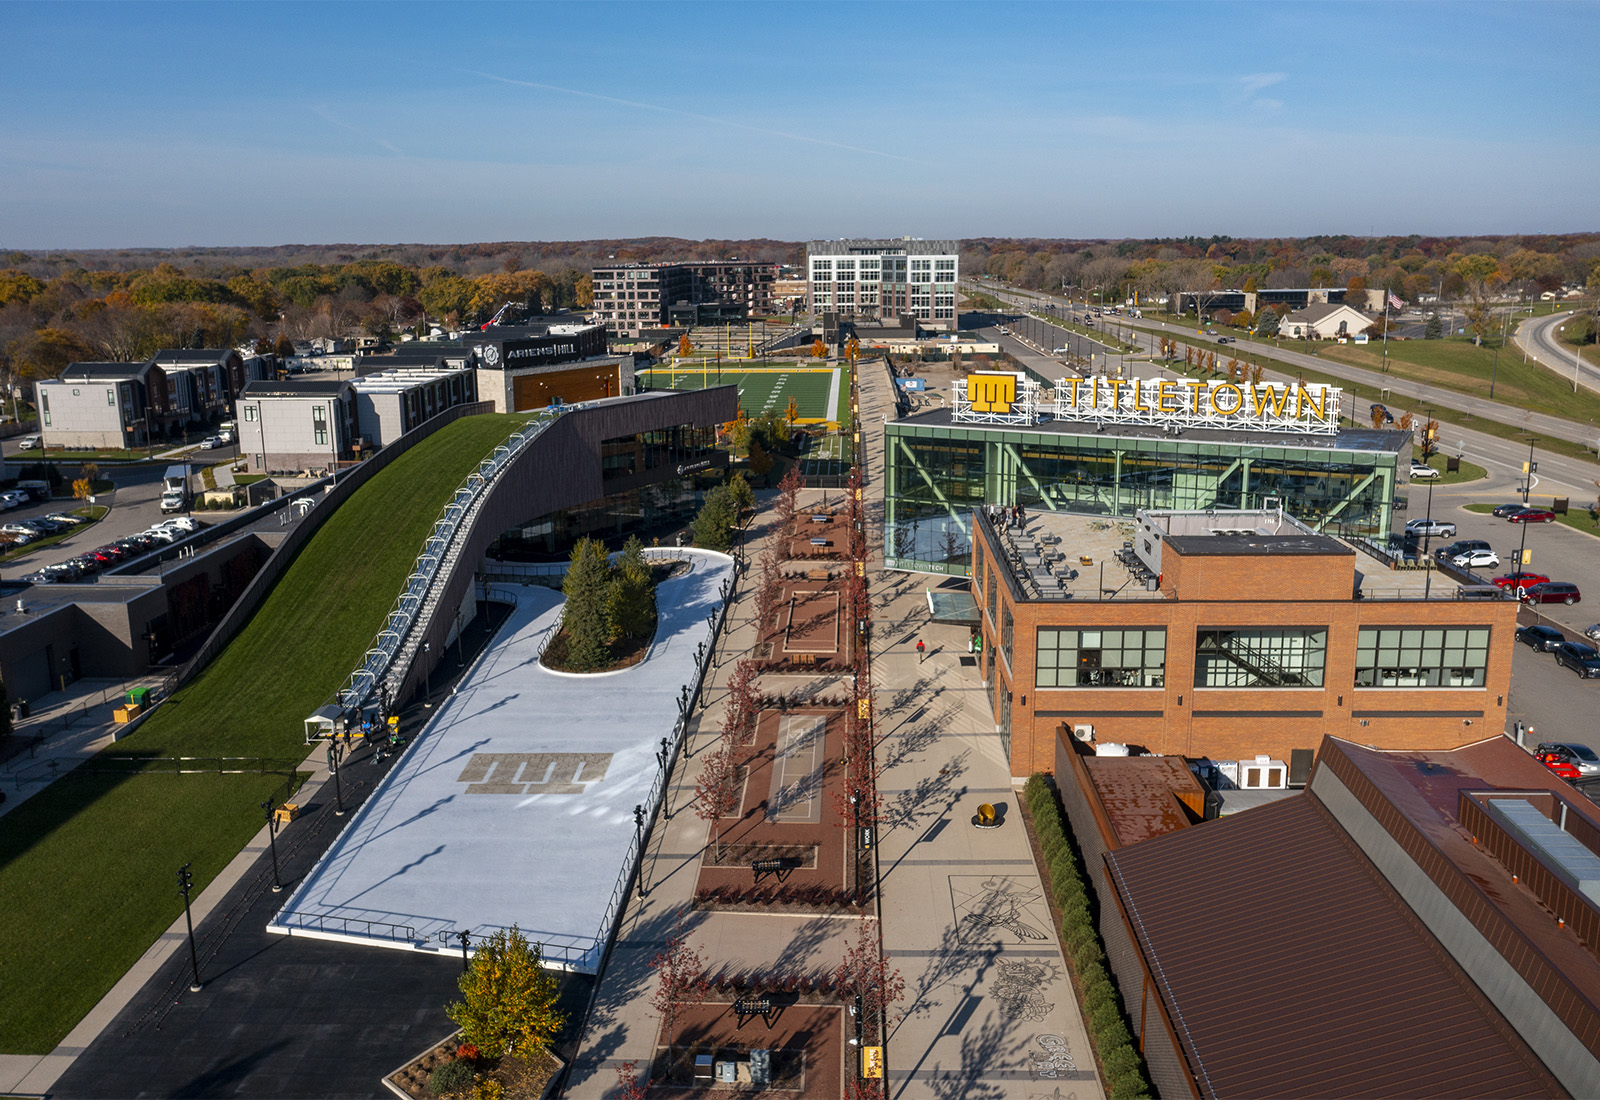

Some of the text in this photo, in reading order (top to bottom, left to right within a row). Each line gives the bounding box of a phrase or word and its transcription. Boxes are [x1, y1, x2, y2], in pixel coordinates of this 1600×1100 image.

[507, 344, 576, 358] ARIENS HILL
[1064, 377, 1326, 420] TITLETOWN
